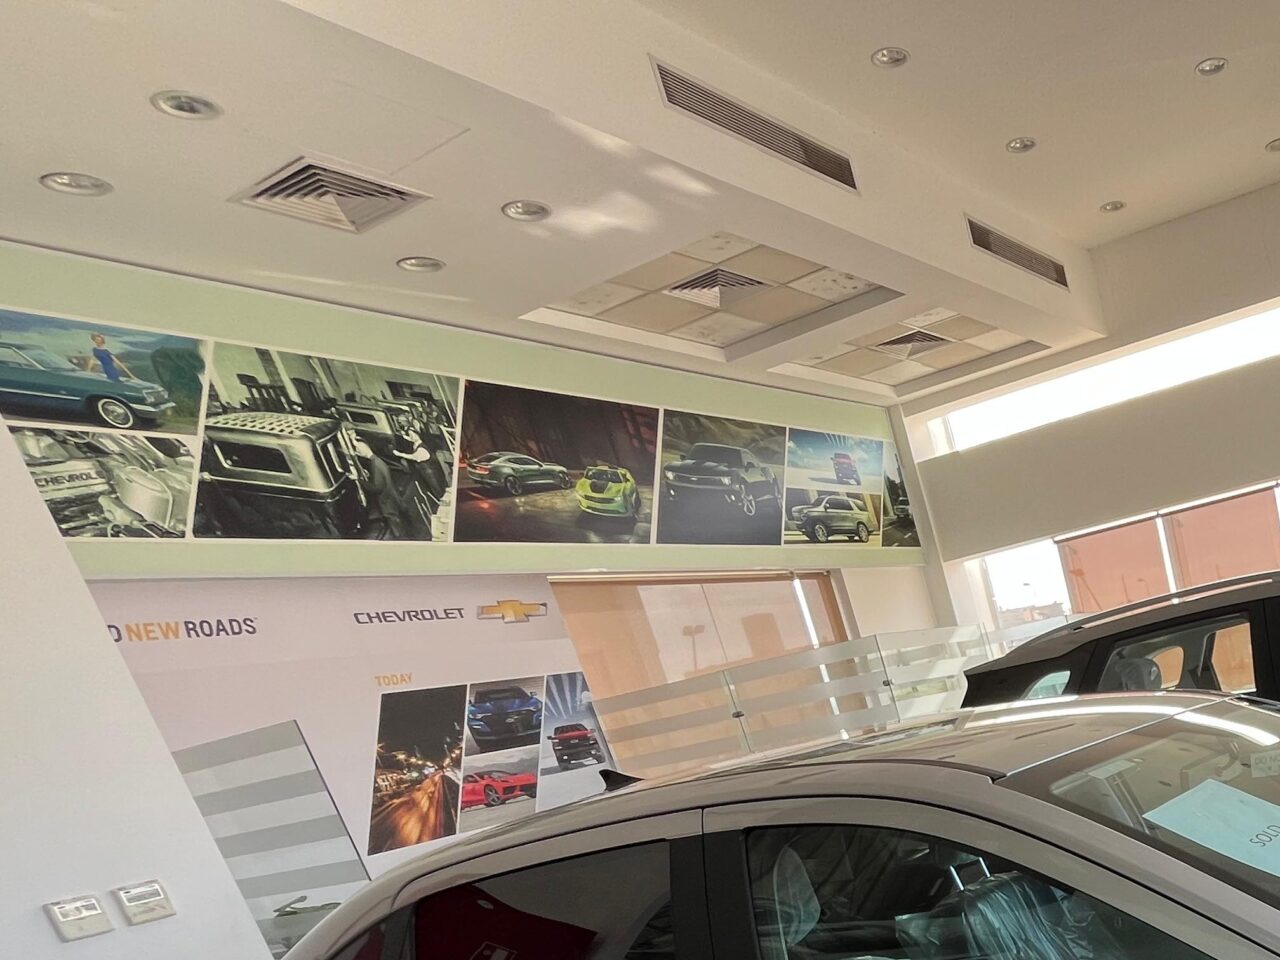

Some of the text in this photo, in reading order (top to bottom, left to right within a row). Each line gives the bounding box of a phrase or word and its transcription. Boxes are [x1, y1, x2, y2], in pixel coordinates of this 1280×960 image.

[353, 607, 465, 625] CHEVROLET
[124, 621, 181, 642] NEW
[183, 617, 257, 638] ROADS
[374, 672, 413, 687] TODAY
